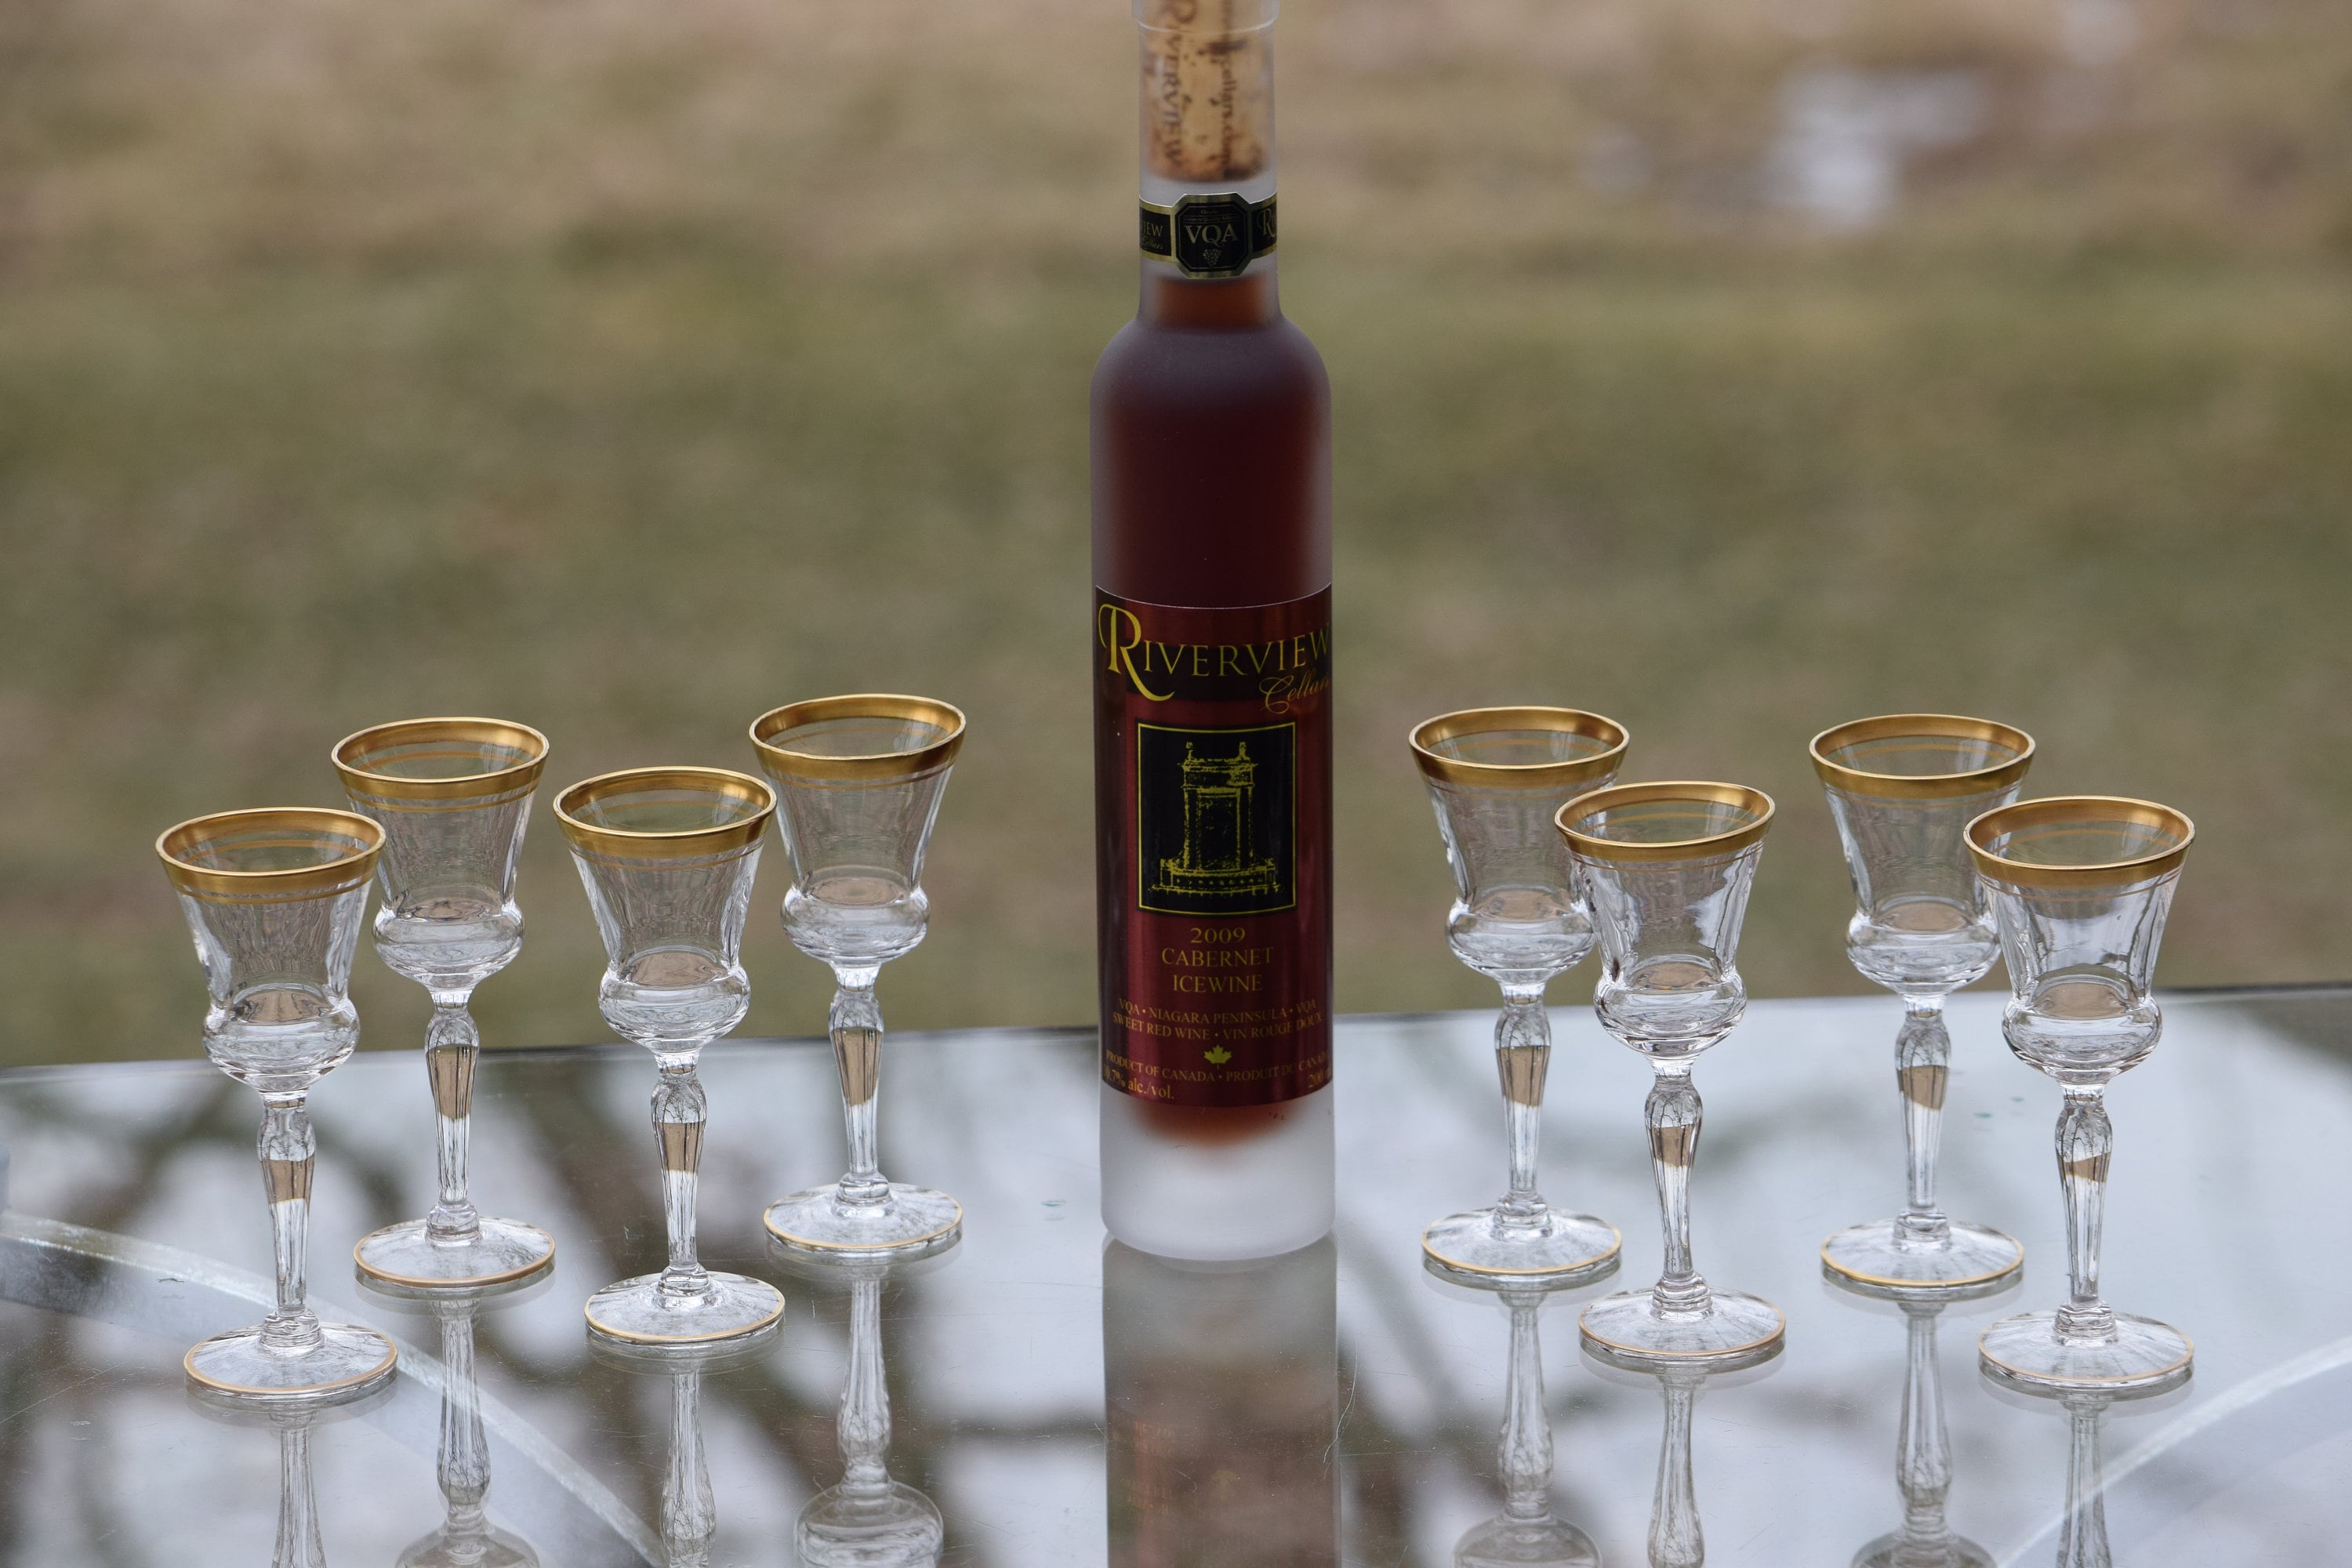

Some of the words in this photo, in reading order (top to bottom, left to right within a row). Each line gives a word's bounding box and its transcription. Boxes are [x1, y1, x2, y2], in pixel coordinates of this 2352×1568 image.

[1184, 223, 1238, 247] VQA
[1098, 603, 1330, 701] RIVERVIEW
[1190, 927, 1247, 944] 2009
[1161, 947, 1275, 967] CABERNET
[1173, 974, 1263, 993] ICEWINE
[1118, 997, 1140, 1015] VQA
[1149, 1007, 1210, 1024] NIAGARA
[1214, 1007, 1288, 1025] PENINSULA
[1296, 997, 1317, 1014] VQA
[1112, 1011, 1145, 1033] SWEET
[1147, 1022, 1172, 1037] RED
[1174, 1026, 1211, 1040] WINE
[1222, 1028, 1248, 1040] VIN
[1250, 1022, 1294, 1039] ROUGE
[1297, 1011, 1323, 1031] DOUX
[1105, 1048, 1145, 1073] PRODUCT
[1145, 1065, 1160, 1076] OF
[1161, 1068, 1216, 1083] CANADA
[1226, 1065, 1280, 1082] PRODUIT
[1282, 1063, 1294, 1075] DU
[1127, 1077, 1176, 1100] alc./vol.
